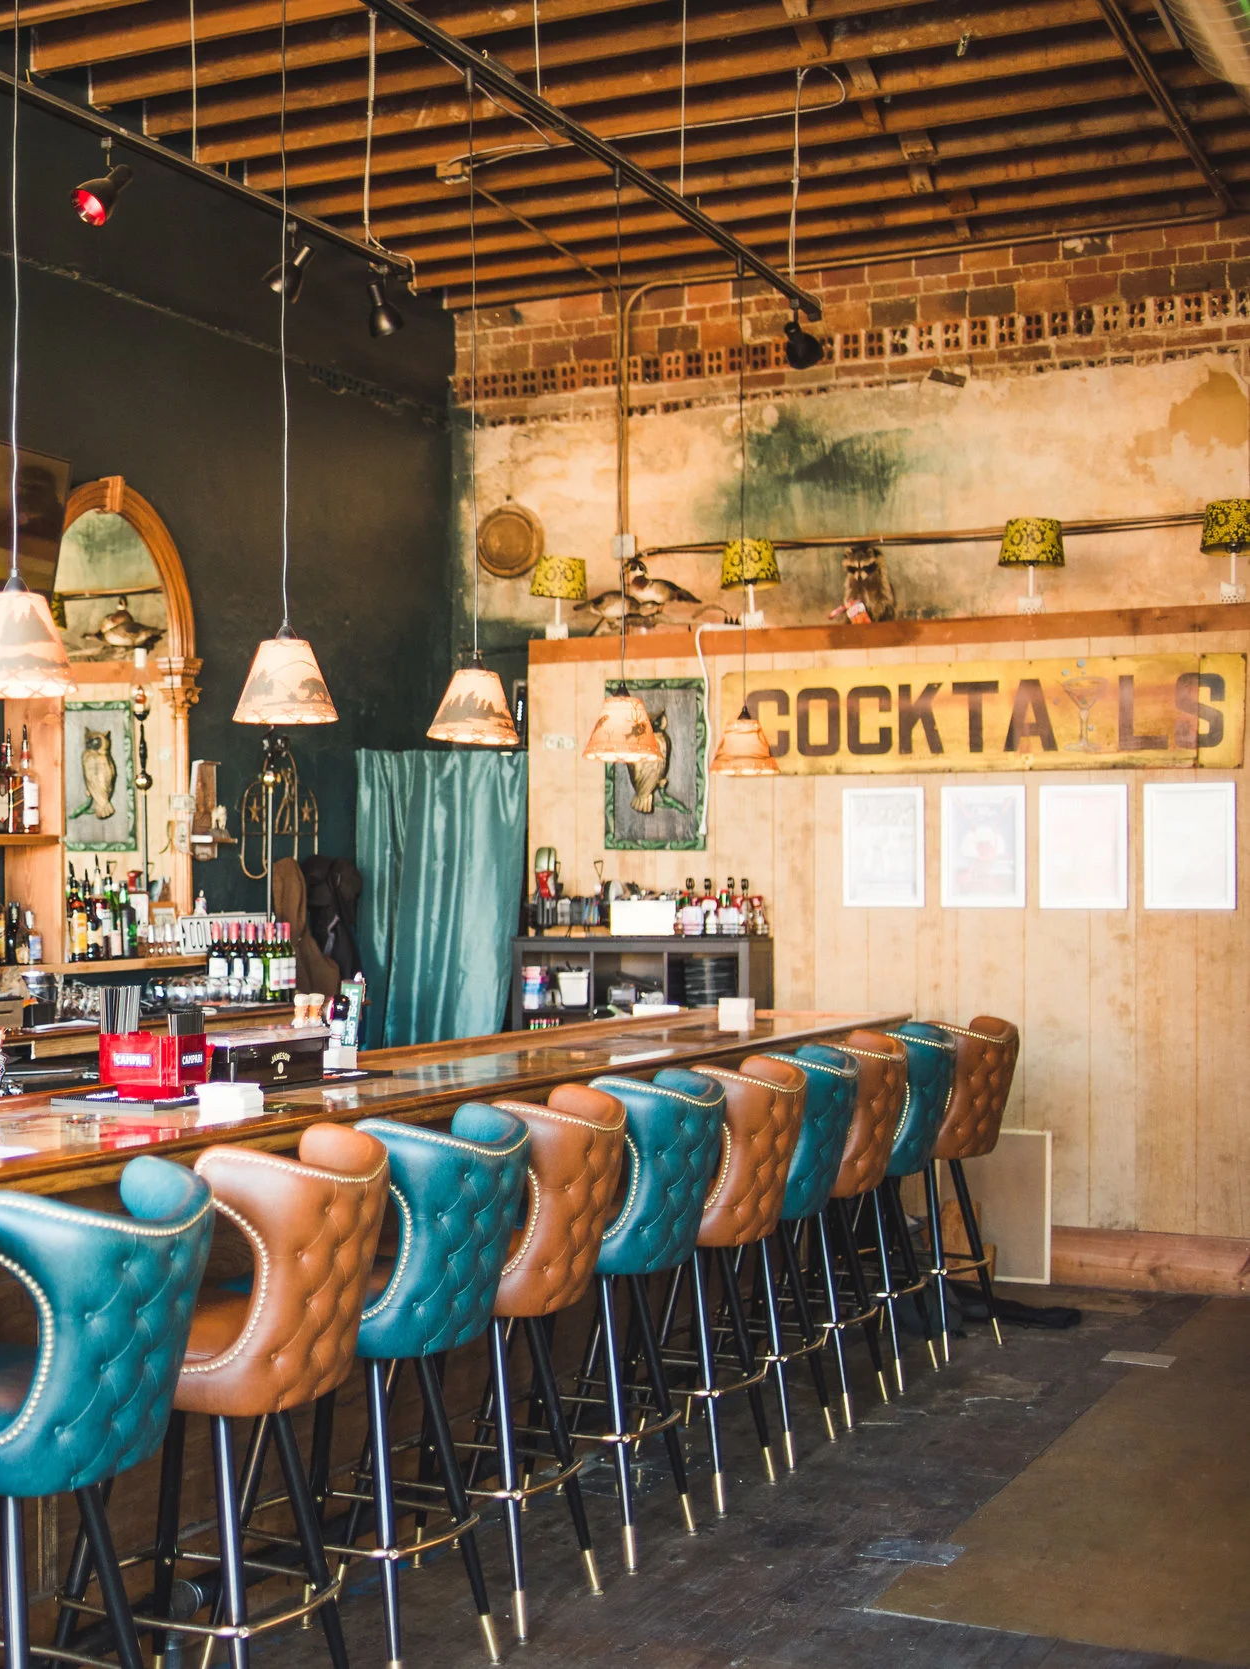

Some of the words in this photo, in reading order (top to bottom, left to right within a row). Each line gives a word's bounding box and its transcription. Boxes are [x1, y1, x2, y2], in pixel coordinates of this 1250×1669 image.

[748, 672, 1225, 758] COCKTALS
[115, 1054, 150, 1065] CAMPARI
[182, 1053, 203, 1065] CAMPARI
[271, 1051, 291, 1065] JAMESON
